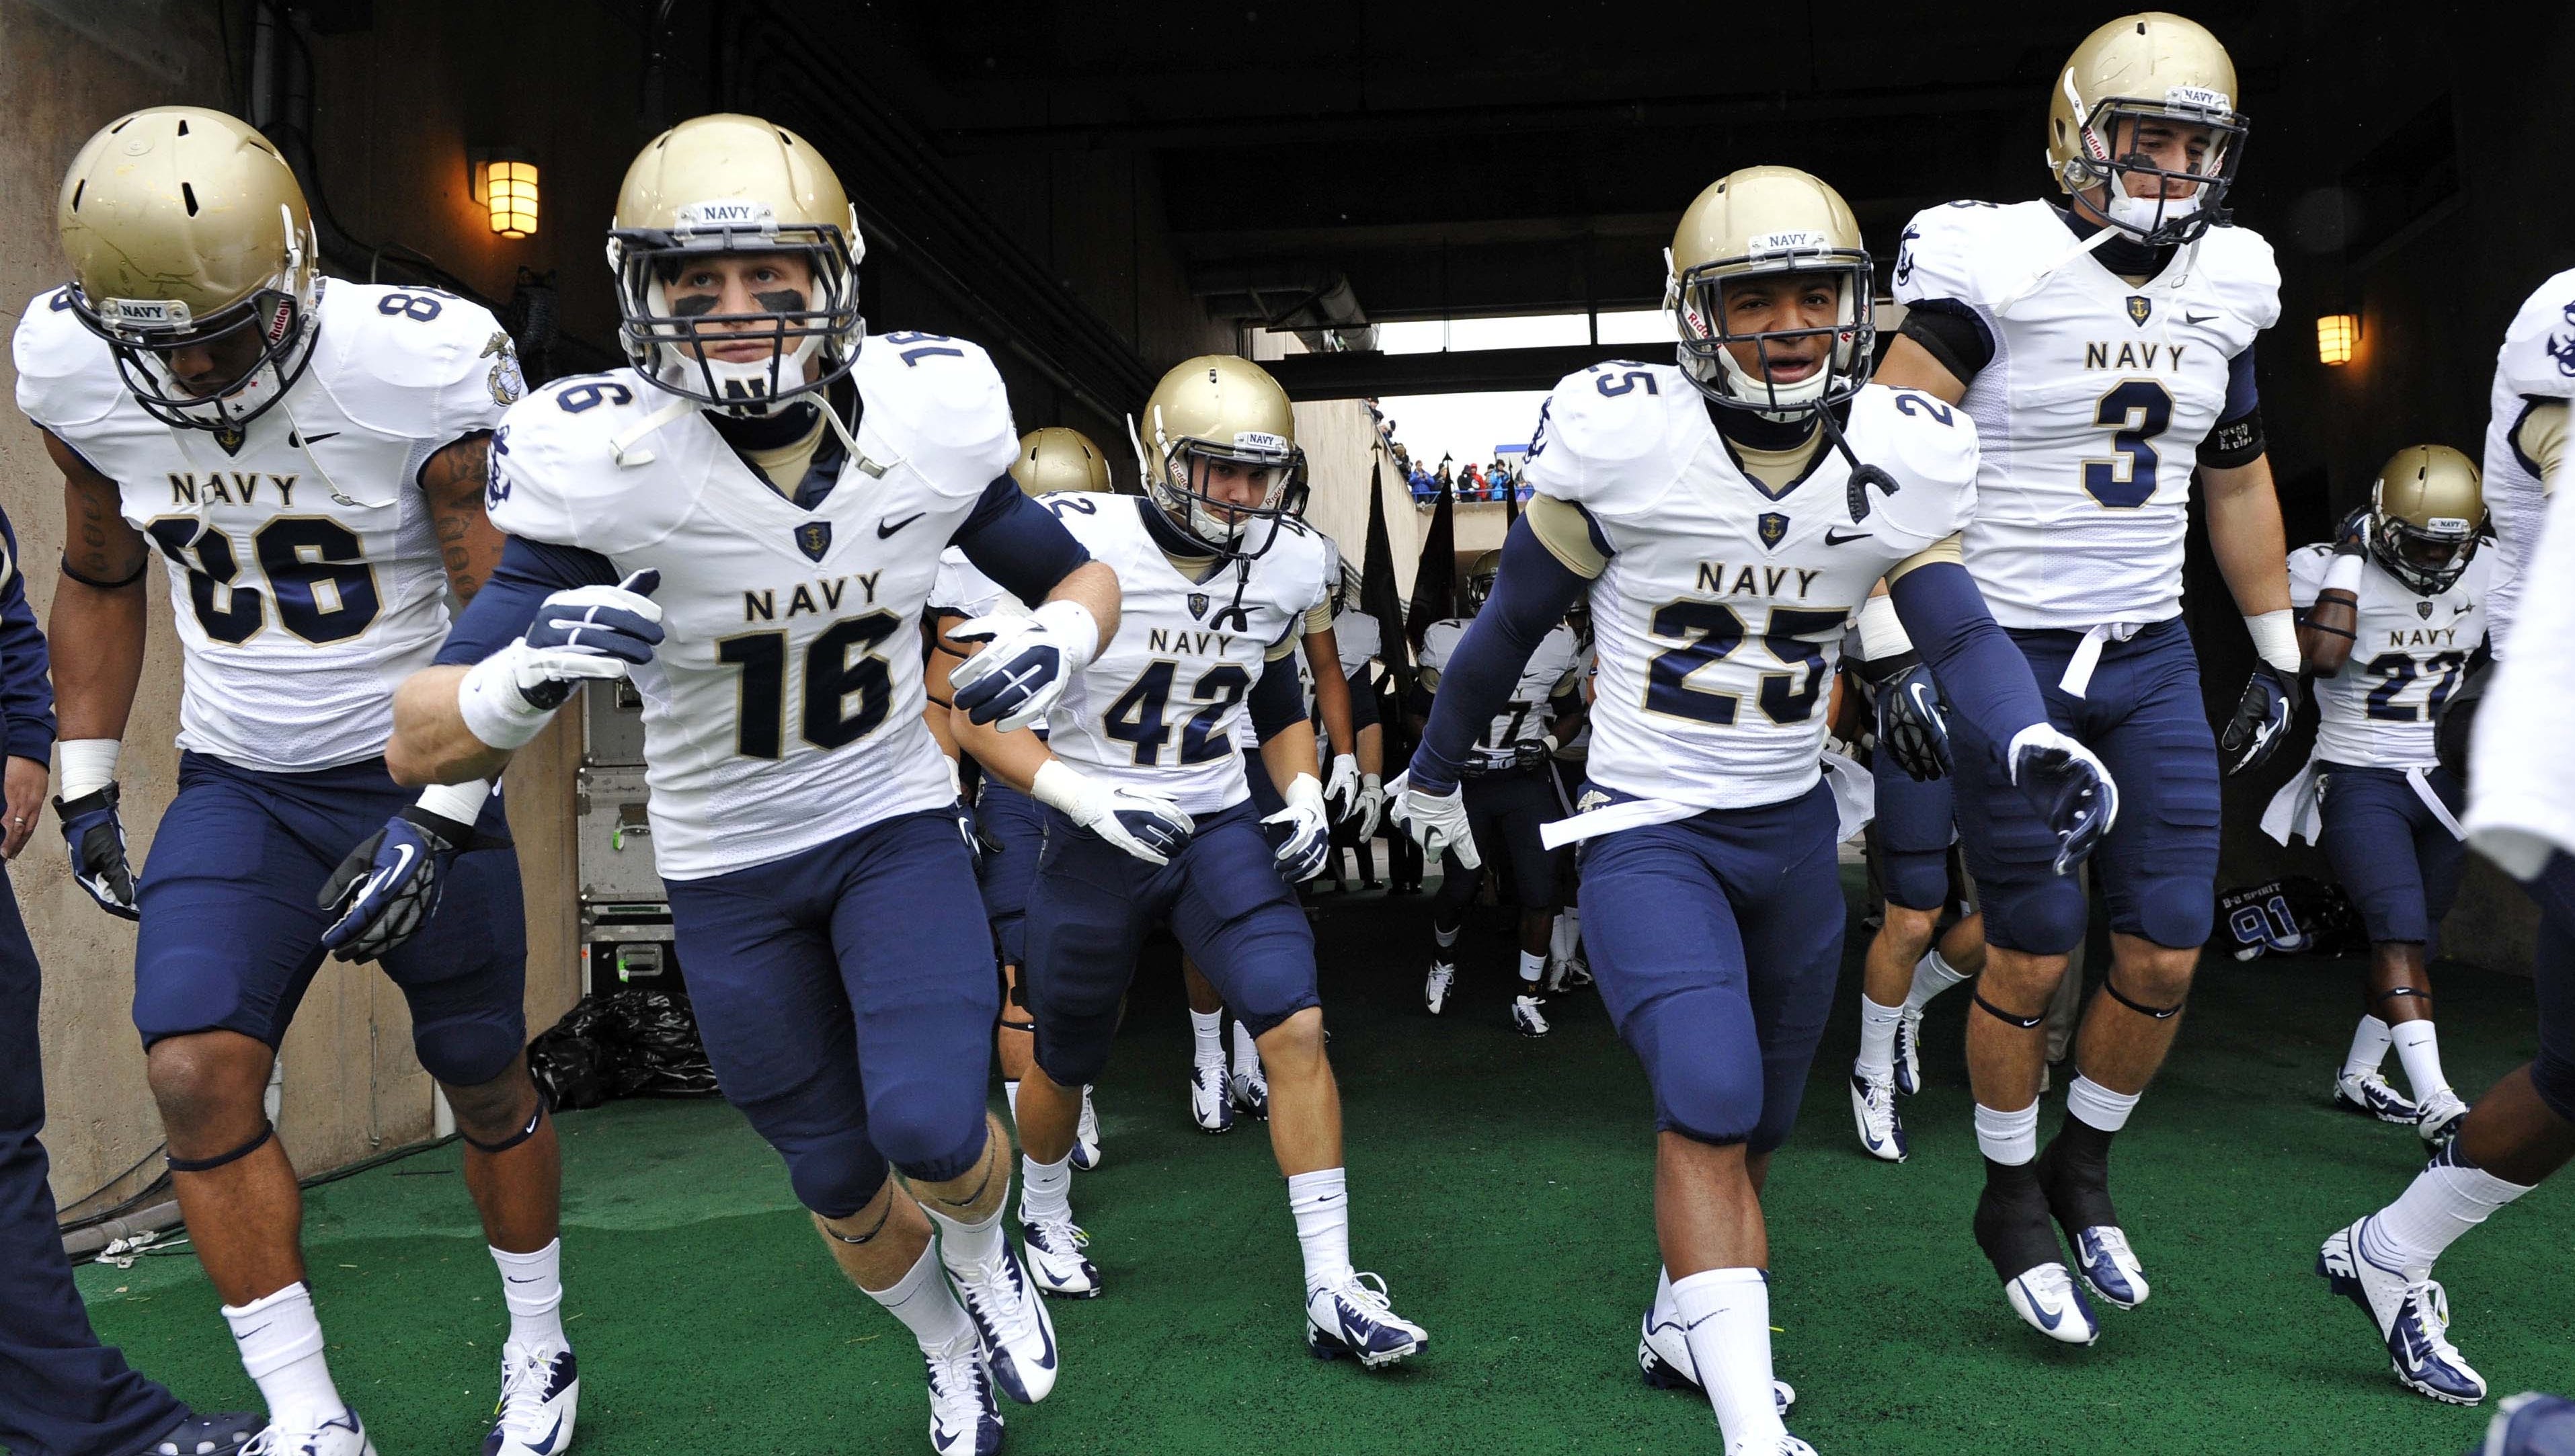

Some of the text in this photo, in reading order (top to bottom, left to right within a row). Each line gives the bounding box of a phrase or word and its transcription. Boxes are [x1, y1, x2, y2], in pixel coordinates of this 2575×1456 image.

[2184, 89, 2213, 104] NAVY
[704, 206, 750, 219] NAVY
[1769, 233, 1807, 247] NAVY
[120, 305, 161, 318] NAVY
[269, 301, 291, 341] Riddell
[377, 284, 460, 323] 8
[2084, 341, 2188, 374] NAVY
[1250, 434, 1274, 445] NAVY
[2080, 377, 2176, 512] 3
[167, 471, 300, 508] NAVY
[144, 514, 386, 649] 86
[743, 569, 884, 624] NAVY
[1694, 560, 1823, 600] NAVY
[1147, 627, 1236, 658] NAVY
[2389, 629, 2457, 646] NAVY
[1640, 596, 1852, 728] 25
[714, 607, 903, 762] 16
[1101, 657, 1253, 768] 42
[2244, 883, 2280, 901] SPIRIT
[2230, 895, 2302, 960] 91
